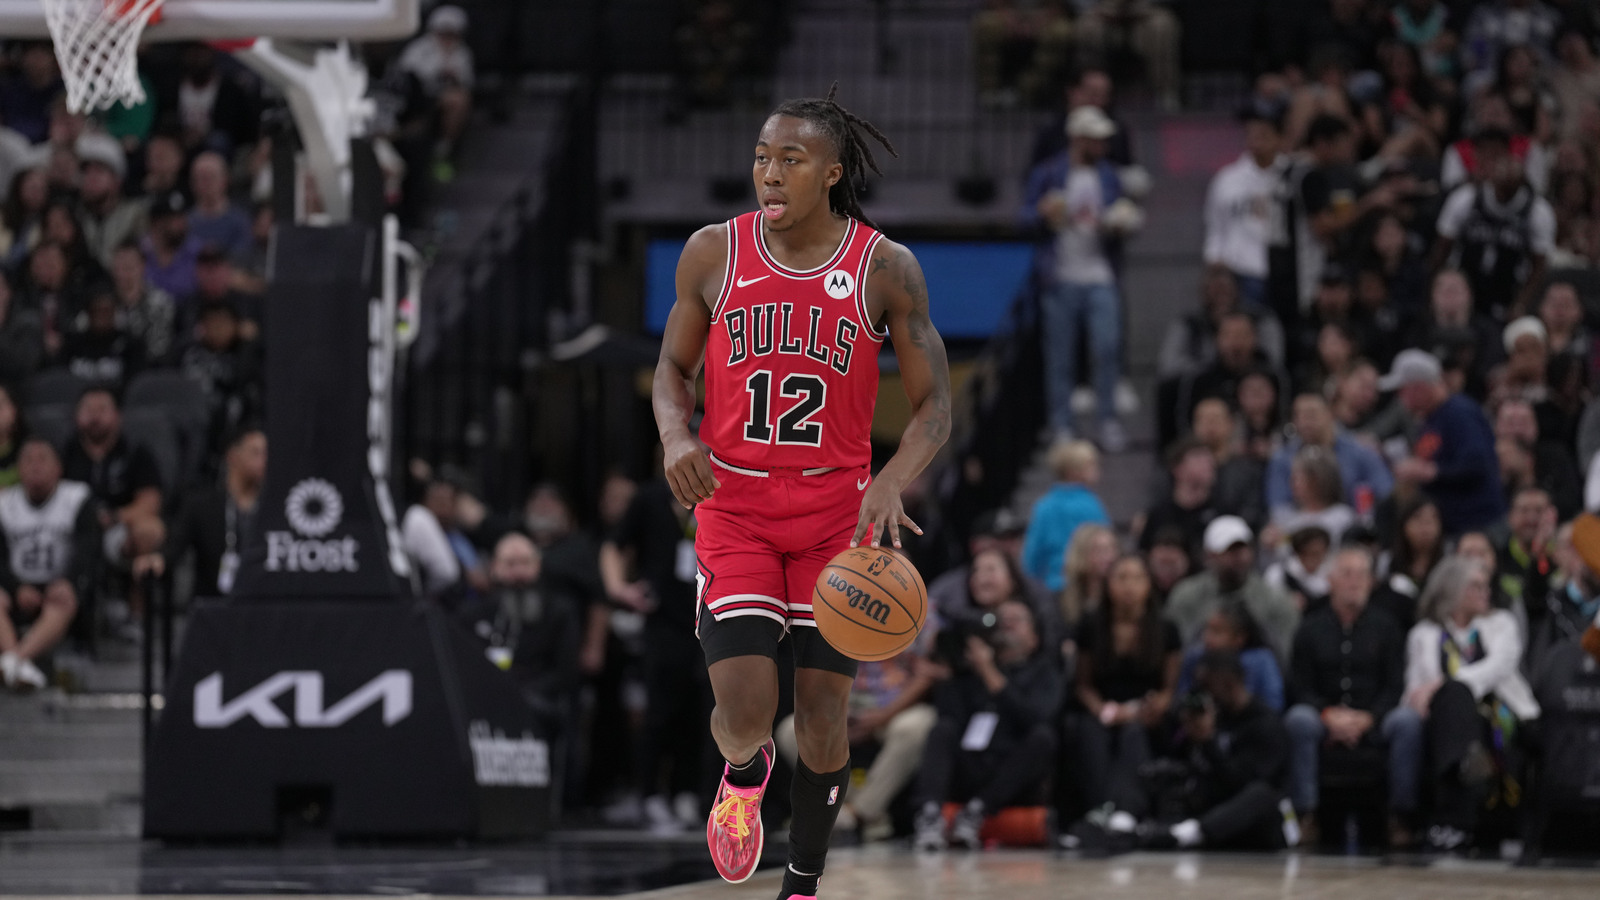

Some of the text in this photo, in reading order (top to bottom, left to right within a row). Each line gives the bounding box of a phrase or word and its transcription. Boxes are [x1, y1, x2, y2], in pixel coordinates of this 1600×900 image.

[724, 302, 859, 376] BULLS
[743, 369, 827, 448] 12
[264, 531, 360, 572] Frost
[826, 572, 891, 625] Wilson
[193, 669, 413, 728] KIA
